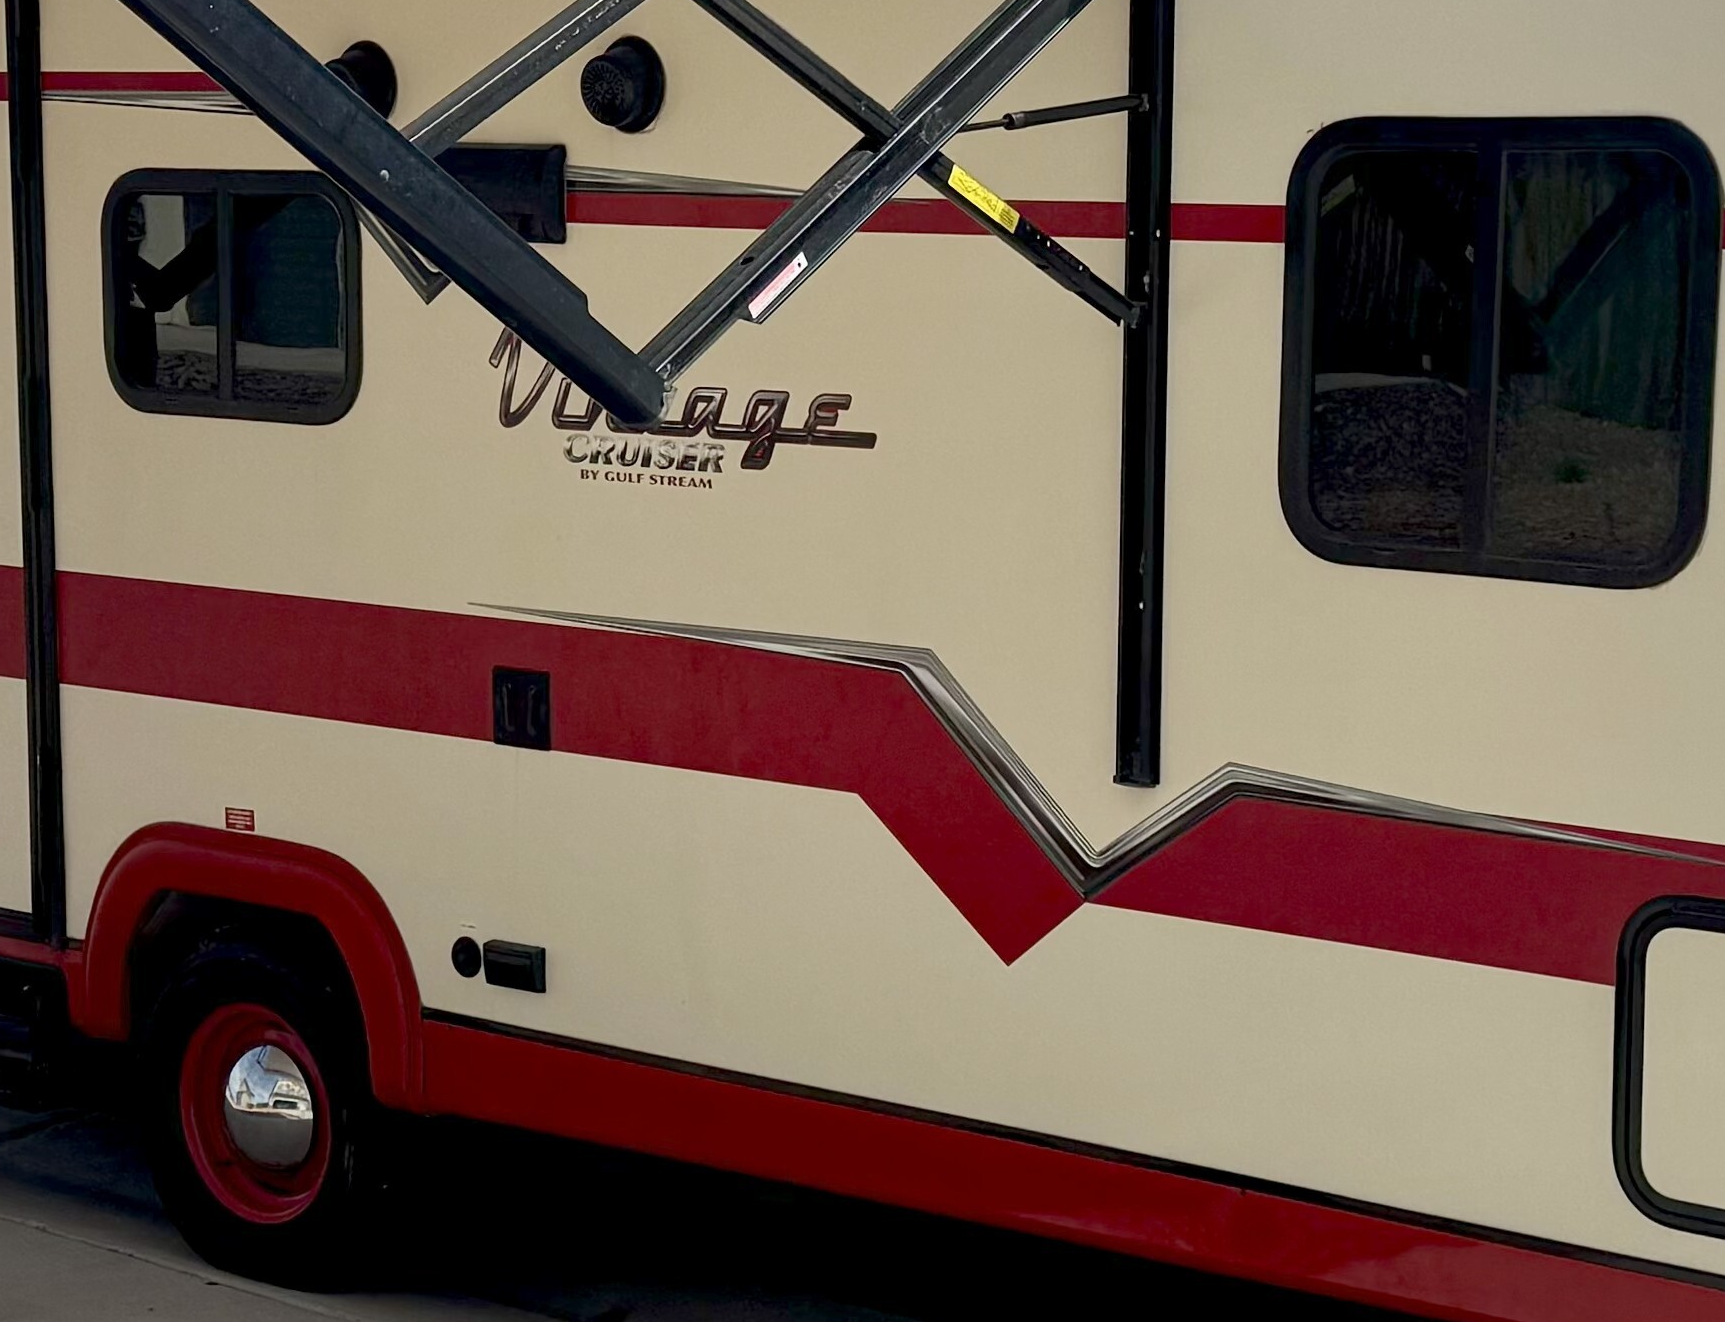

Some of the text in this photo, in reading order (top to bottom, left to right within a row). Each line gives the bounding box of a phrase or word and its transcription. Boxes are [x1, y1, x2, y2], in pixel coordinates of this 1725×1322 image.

[563, 434, 726, 473] CRUISER
[580, 468, 713, 489] BY GULF STREAM
